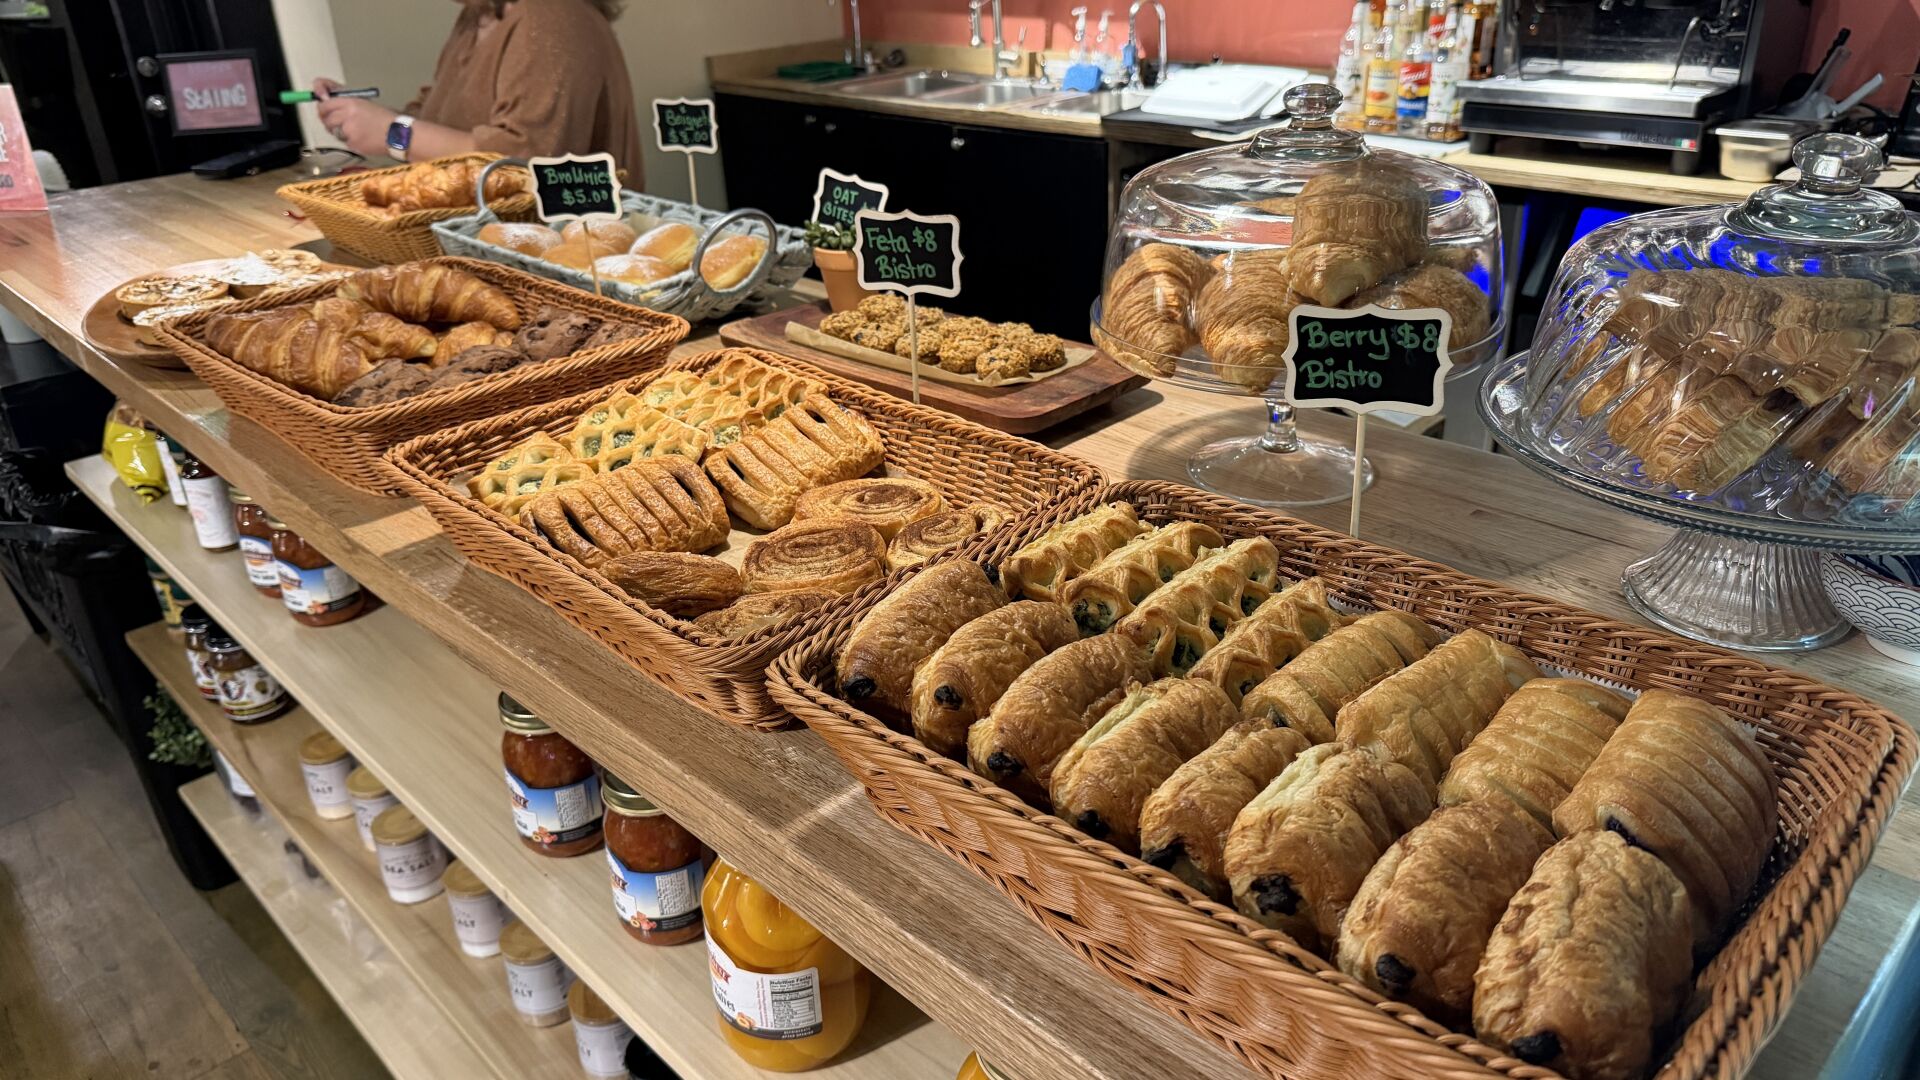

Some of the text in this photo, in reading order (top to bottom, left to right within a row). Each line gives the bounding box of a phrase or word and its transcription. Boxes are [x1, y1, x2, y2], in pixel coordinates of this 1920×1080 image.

[560, 188, 609, 206] $5.00
[832, 186, 860, 206] OAT
[865, 226, 937, 253] Feta $8
[875, 253, 936, 279] Bistro
[1301, 321, 1390, 360] Berry
[1299, 357, 1383, 389] Bistro
[513, 986, 533, 998] ALT
